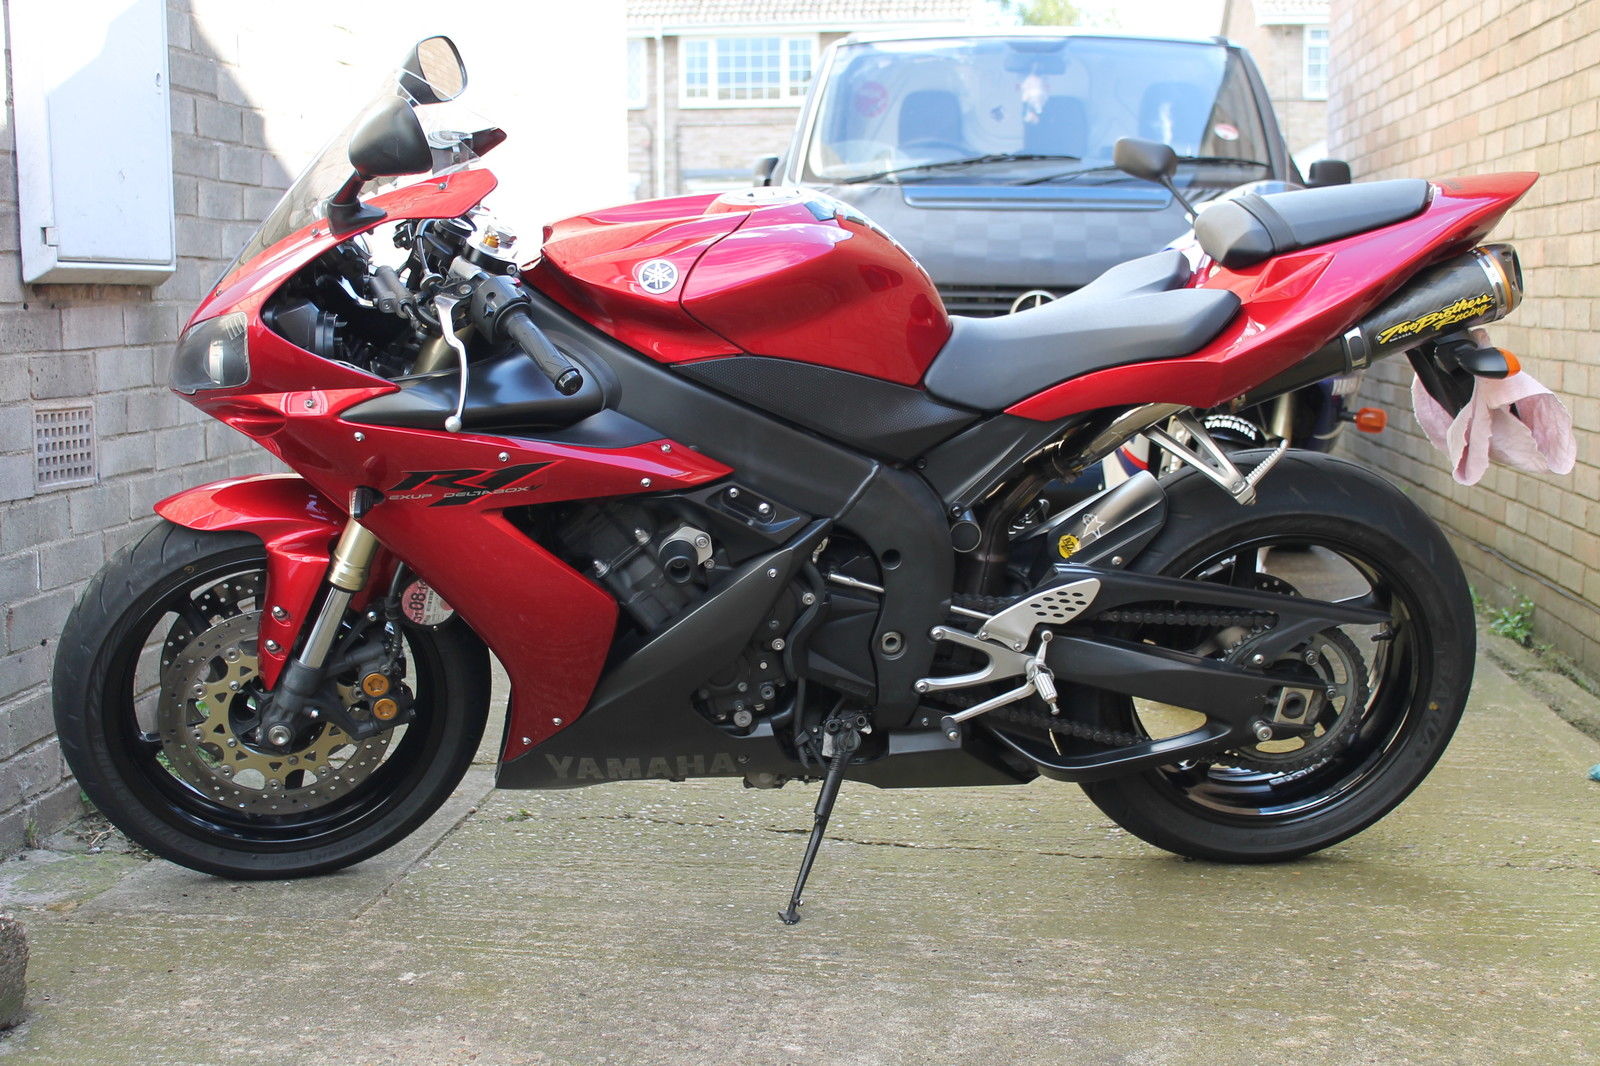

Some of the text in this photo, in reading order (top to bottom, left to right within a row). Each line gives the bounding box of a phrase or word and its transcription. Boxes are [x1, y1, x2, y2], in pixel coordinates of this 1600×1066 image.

[1379, 295, 1493, 344] Two Brothers
[1433, 304, 1492, 331] Racing
[1204, 419, 1256, 441] YAMAHA
[385, 460, 557, 508] R1
[409, 593, 426, 610] 08
[545, 753, 737, 779] YAMAHA
